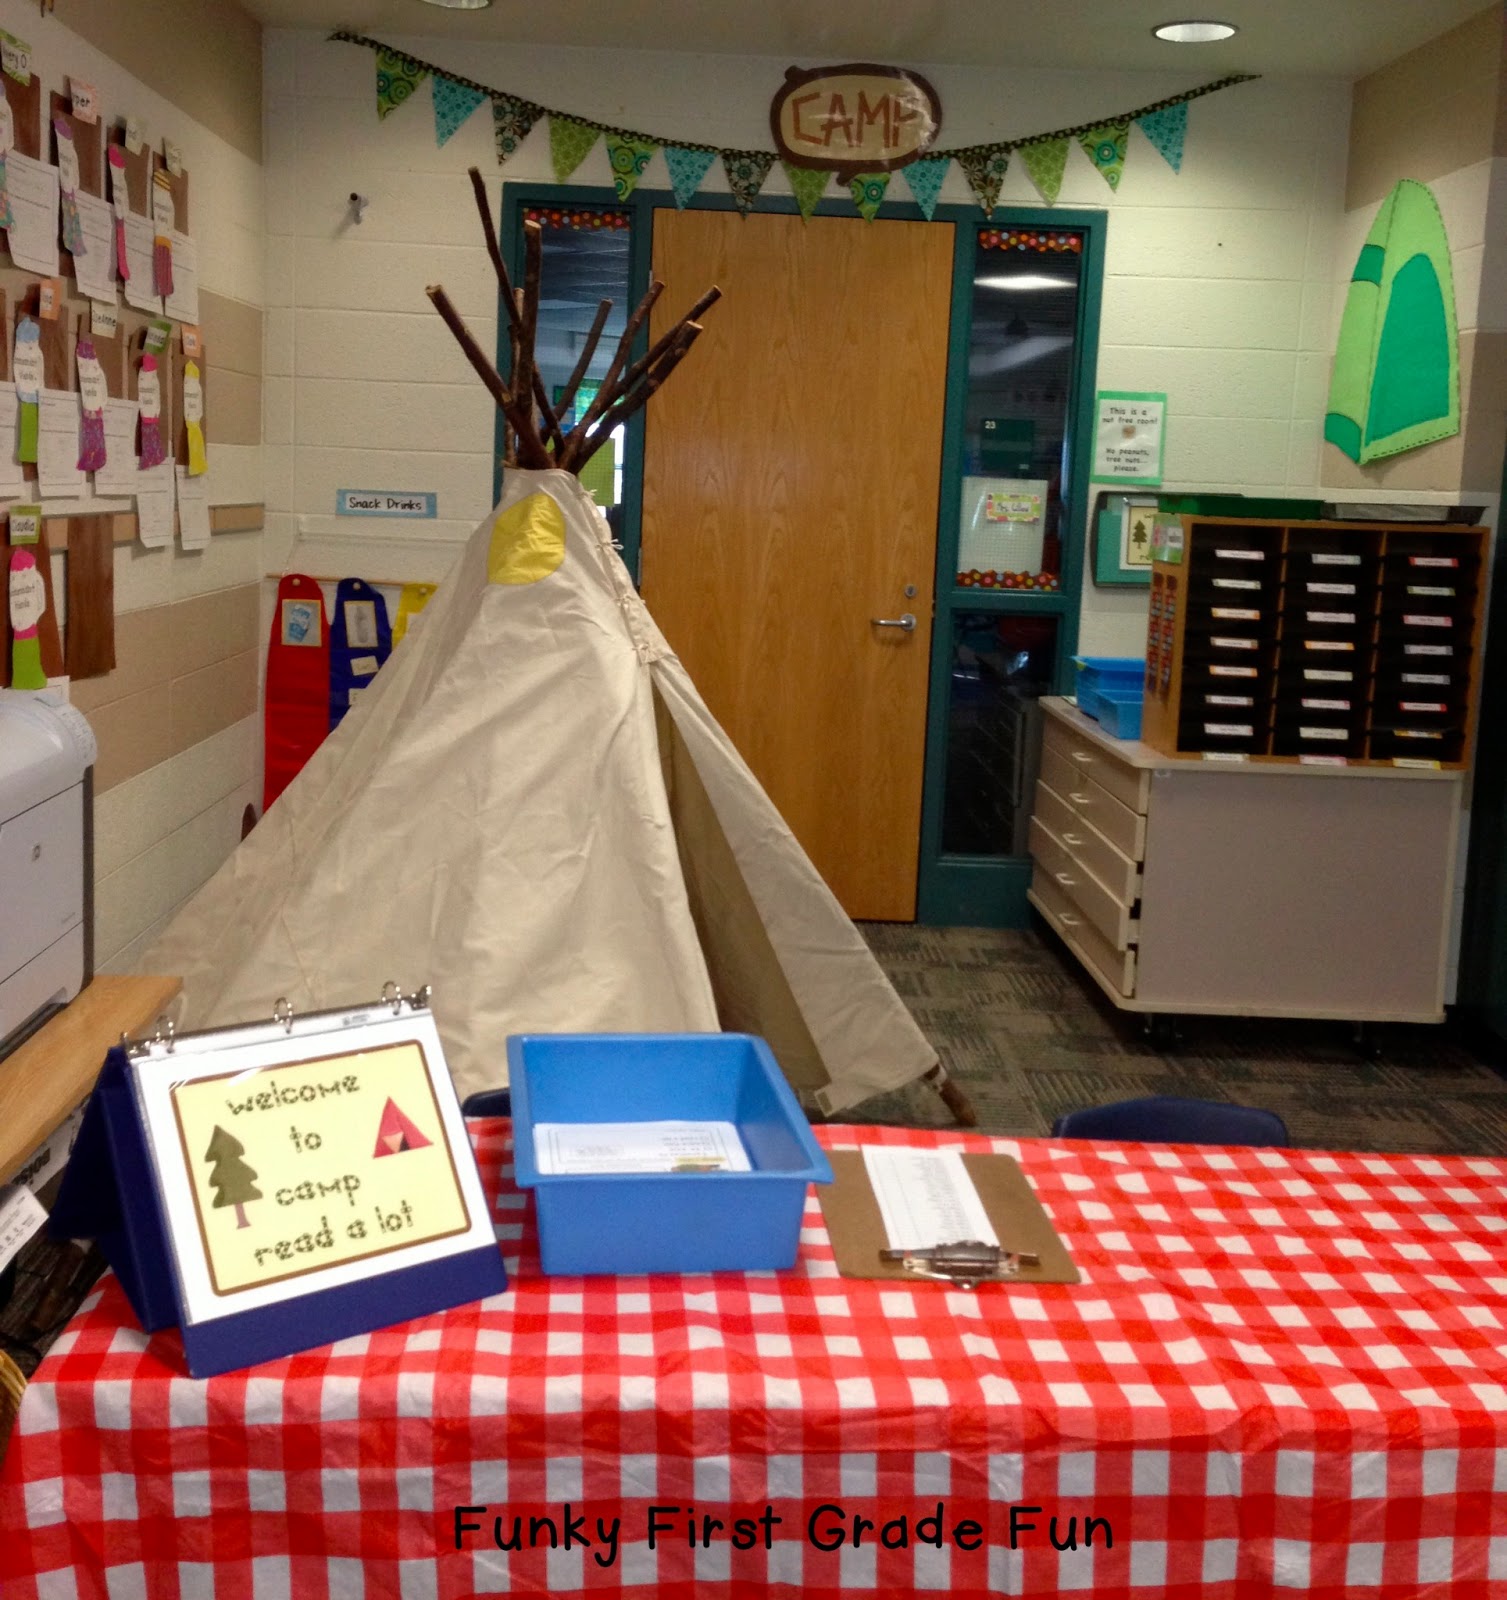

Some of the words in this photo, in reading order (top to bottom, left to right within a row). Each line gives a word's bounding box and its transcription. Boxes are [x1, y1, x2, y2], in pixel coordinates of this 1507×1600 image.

[792, 91, 920, 148] CAMP
[985, 421, 996, 429] 23
[1110, 407, 1125, 415] This
[1131, 407, 1137, 415] is
[1118, 416, 1133, 424] free
[349, 496, 381, 510] Snack
[387, 498, 423, 511] Drinks
[226, 1075, 361, 1115] welcome
[289, 1125, 322, 1153] to
[275, 1174, 361, 1207] camp
[254, 1215, 335, 1266] read
[346, 1219, 368, 1240] a
[375, 1199, 413, 1234] lot
